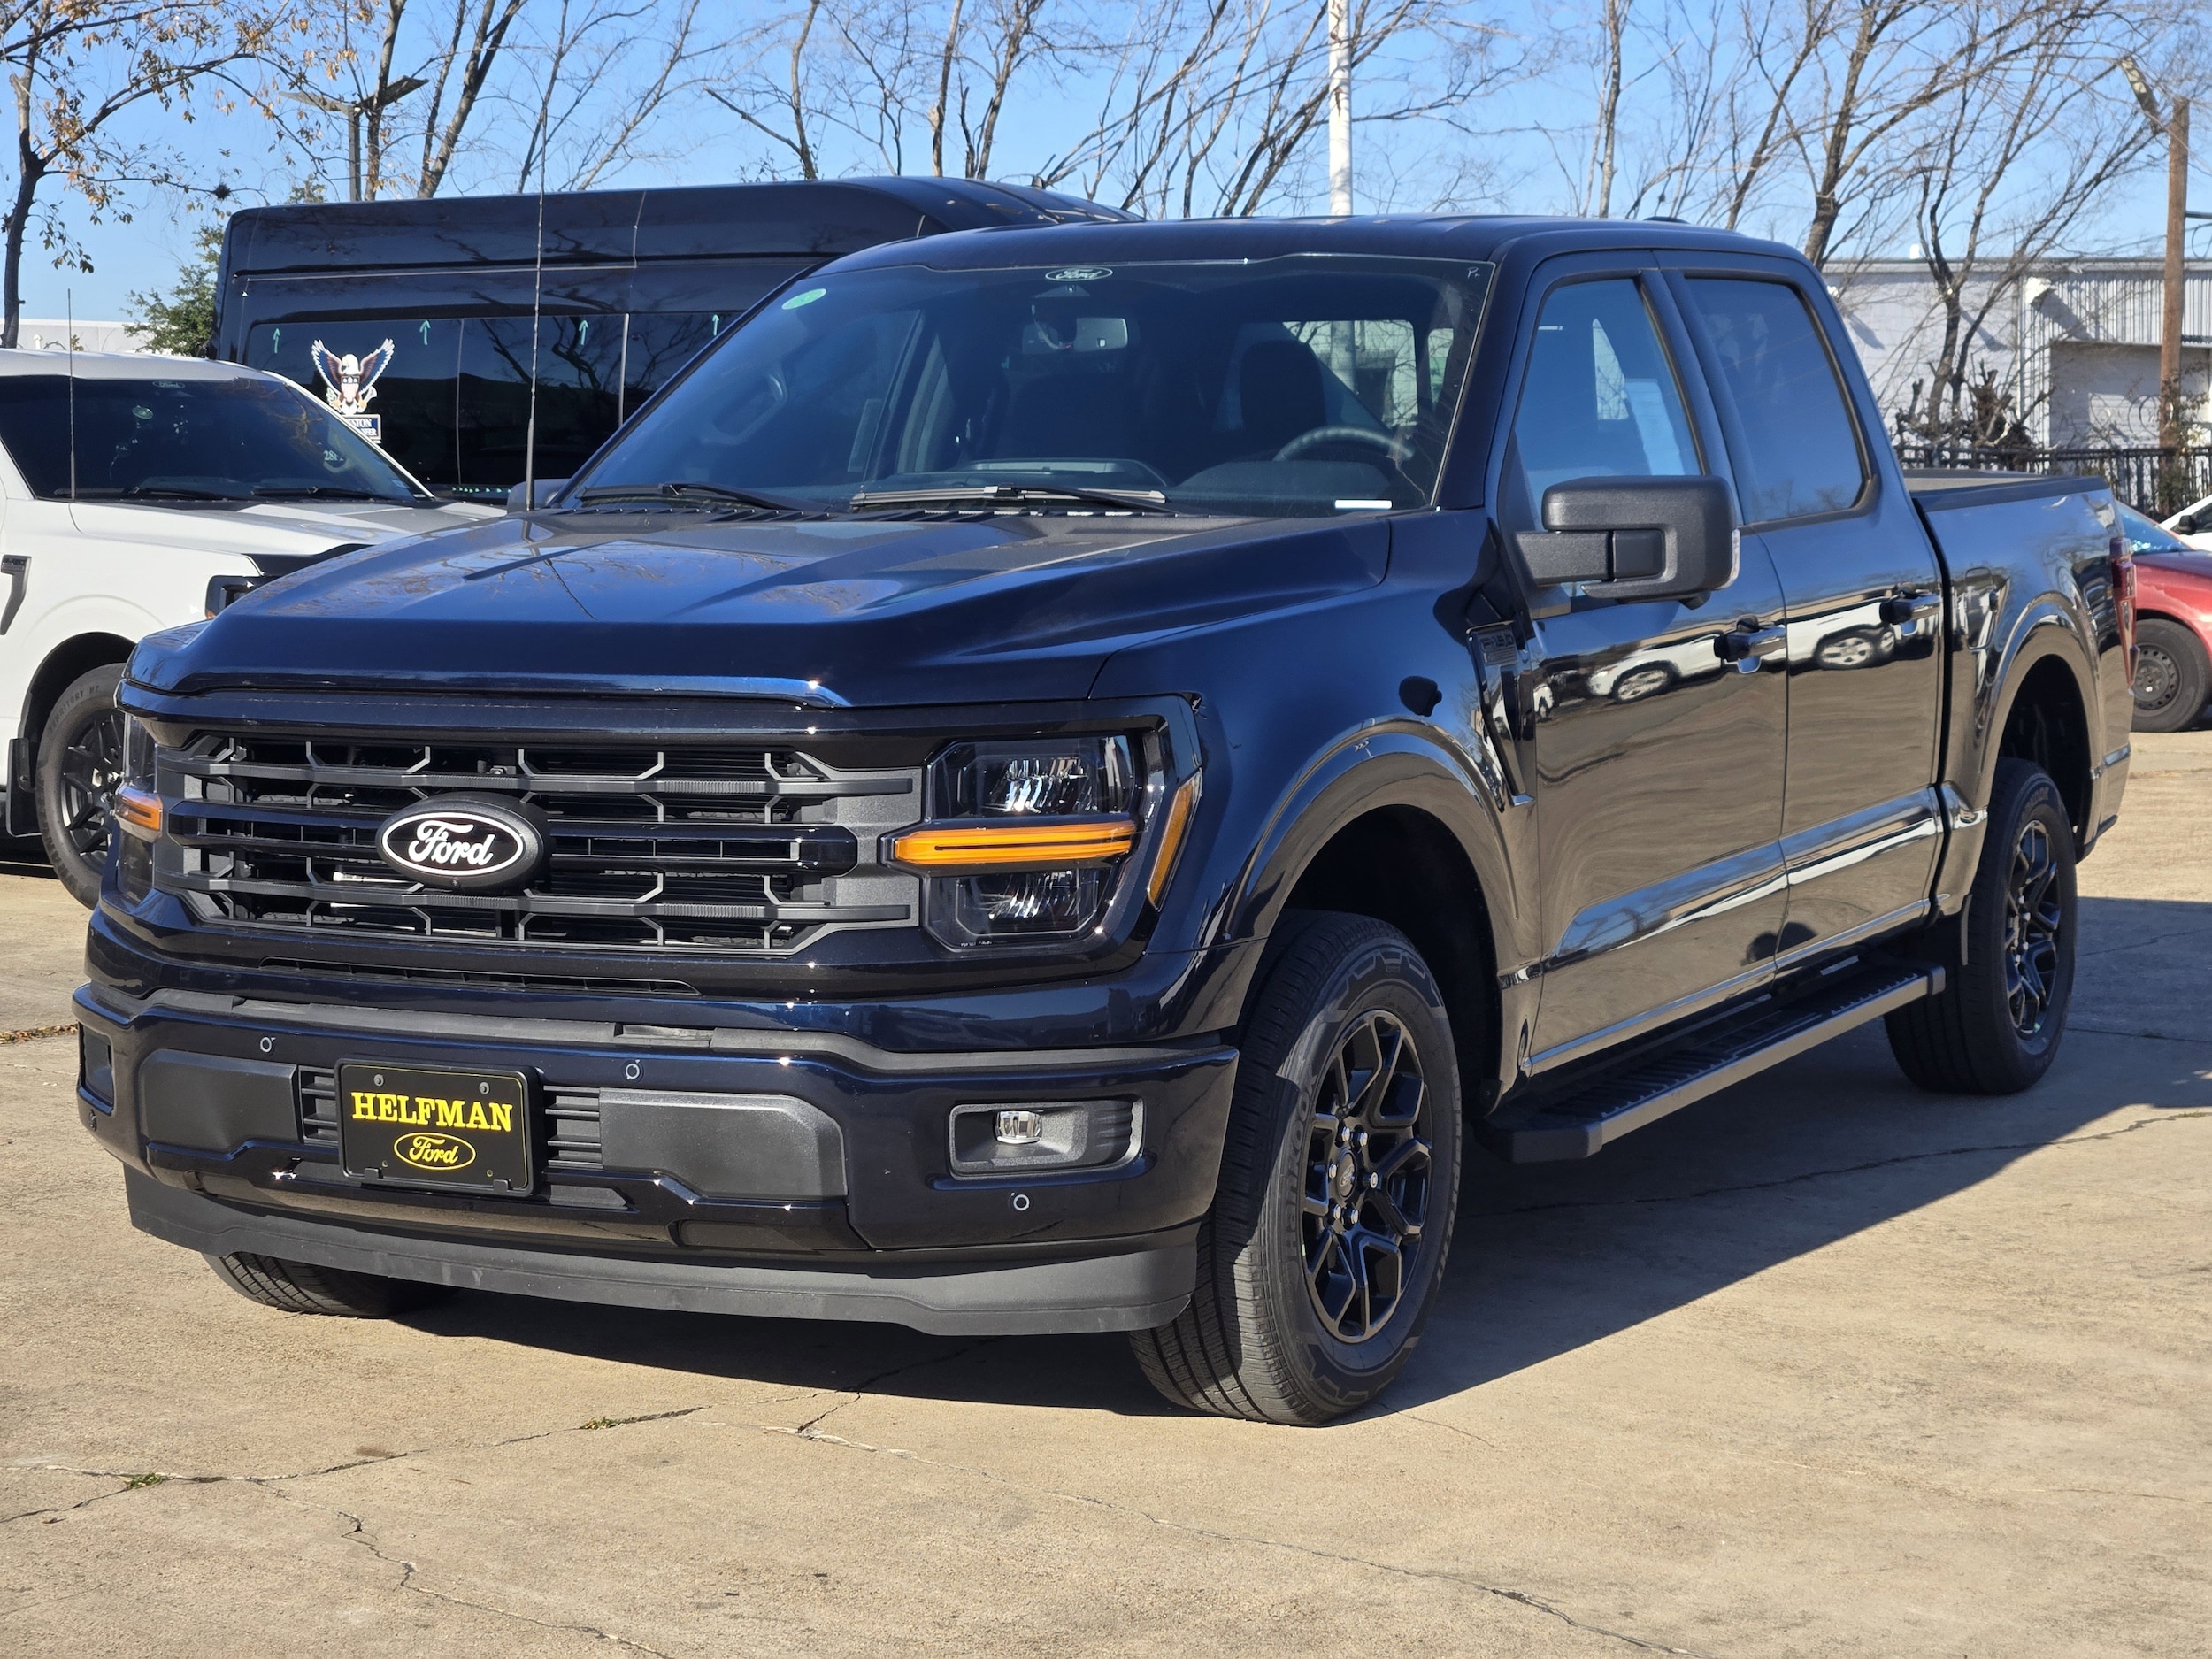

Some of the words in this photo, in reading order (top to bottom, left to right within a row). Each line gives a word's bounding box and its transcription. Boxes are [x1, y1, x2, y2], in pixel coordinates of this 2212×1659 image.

[1056, 267, 1102, 280] Ford
[408, 819, 495, 866] Ford
[350, 1092, 512, 1133] HELFMAN
[409, 1135, 459, 1164] Ford
